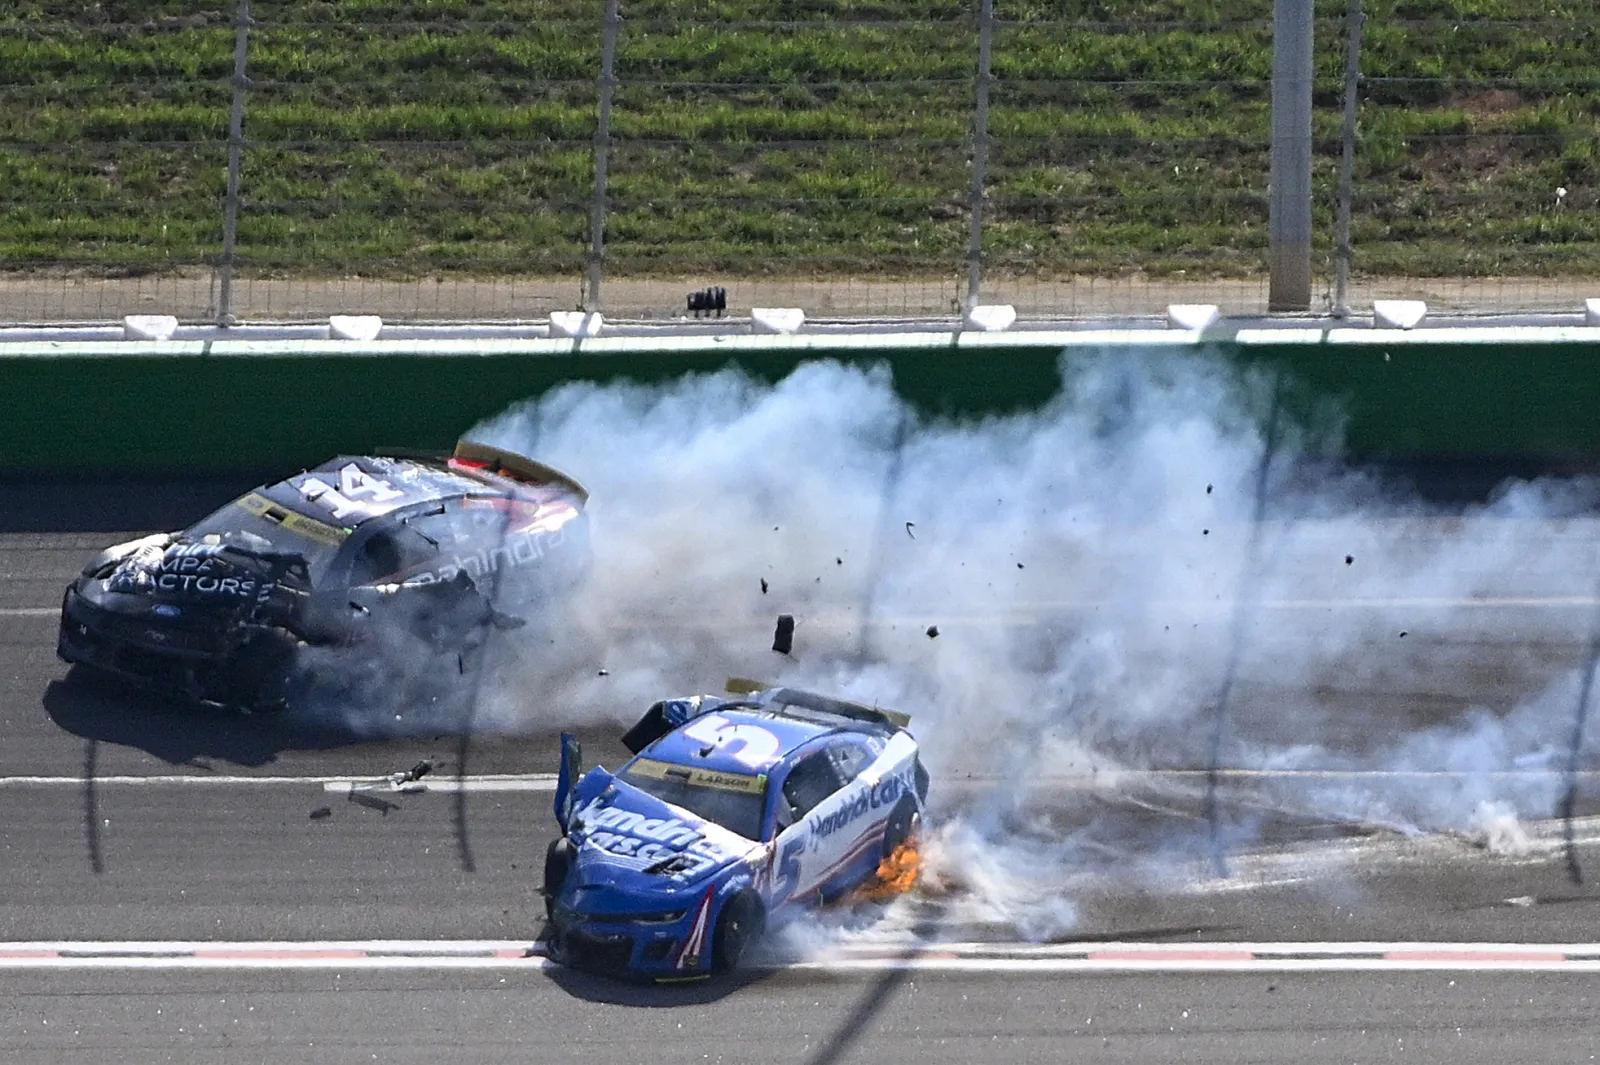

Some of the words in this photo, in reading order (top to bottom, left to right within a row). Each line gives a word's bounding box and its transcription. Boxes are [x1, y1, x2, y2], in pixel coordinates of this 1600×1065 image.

[300, 463, 404, 519] 14
[103, 573, 256, 597] RACTORS
[684, 715, 781, 769] 5
[697, 772, 750, 788] LARSON
